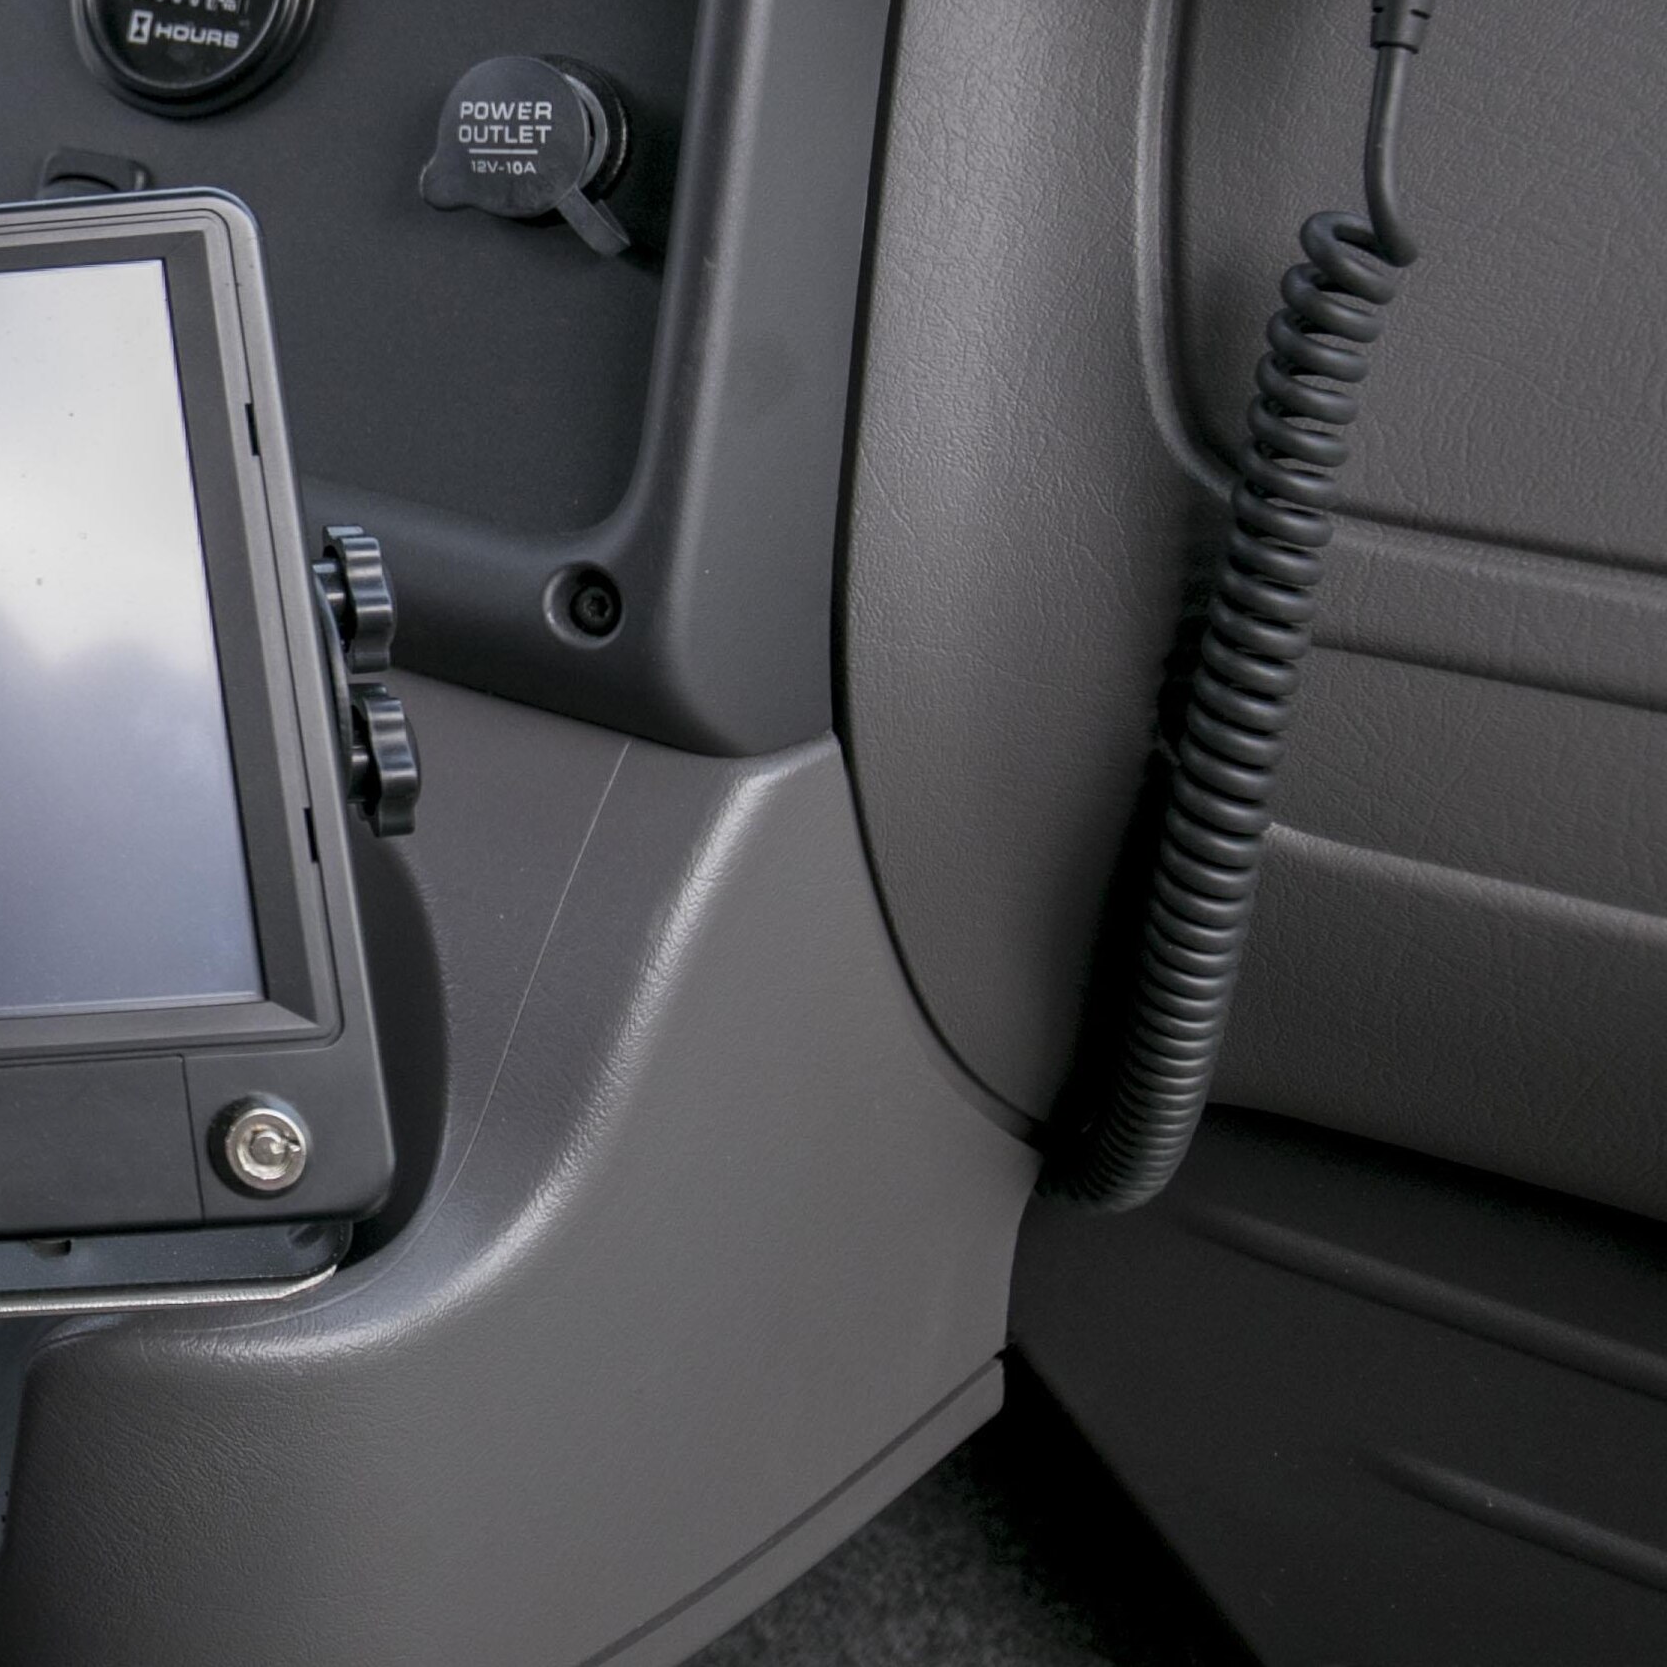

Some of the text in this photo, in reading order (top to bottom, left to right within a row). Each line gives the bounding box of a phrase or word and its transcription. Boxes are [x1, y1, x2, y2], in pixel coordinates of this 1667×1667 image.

[154, 21, 240, 50] HOURS
[460, 101, 553, 121] POWER
[458, 124, 553, 144] OUTLET
[471, 160, 537, 175] 12V-10A
